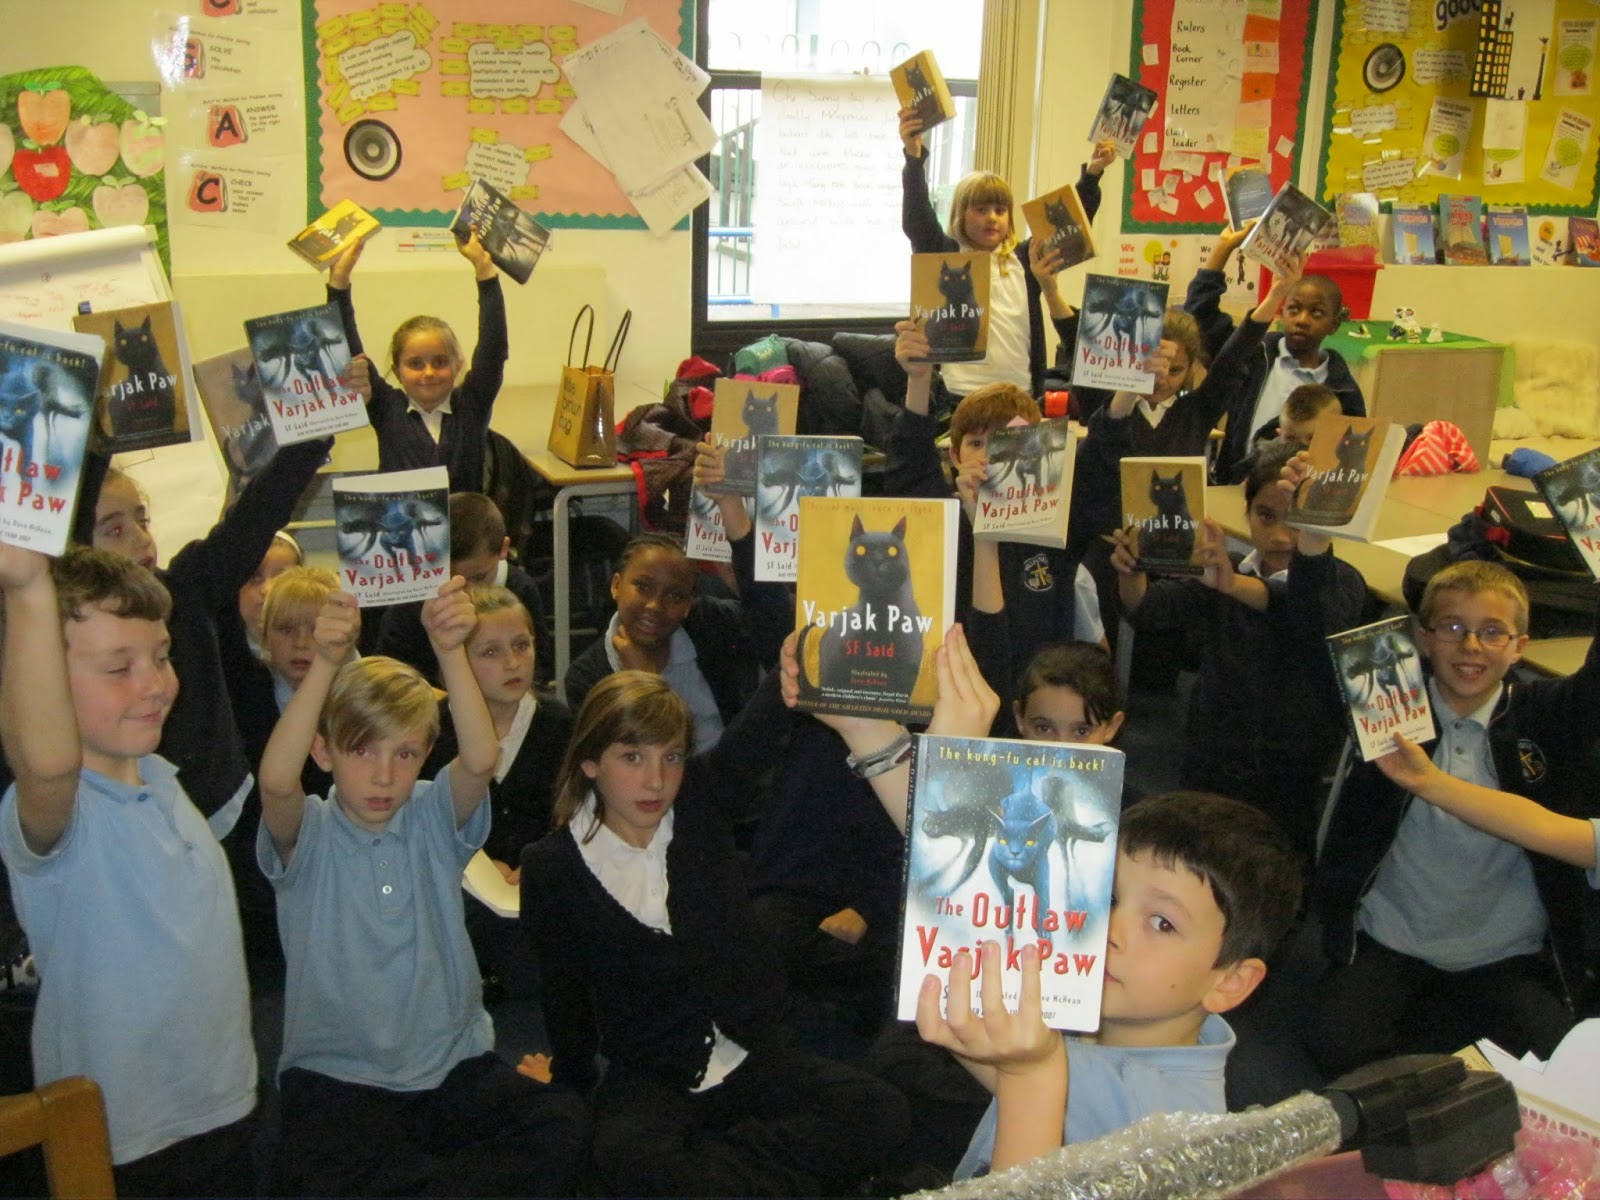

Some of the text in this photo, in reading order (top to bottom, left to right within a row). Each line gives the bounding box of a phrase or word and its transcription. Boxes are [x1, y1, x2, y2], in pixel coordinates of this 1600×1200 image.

[1177, 20, 1205, 33] Rulers
[209, 45, 233, 55] SOLVE
[358, 48, 372, 57] solve
[374, 42, 390, 51] simple
[392, 35, 411, 46] number
[1172, 44, 1191, 54] Book
[344, 59, 369, 72] problems
[1176, 55, 1203, 64] Corner
[1169, 75, 1206, 91] Register
[246, 105, 276, 114] ANSWER
[215, 111, 239, 140] A
[497, 158, 517, 167] number
[197, 178, 220, 205] C
[231, 179, 253, 187] CHECK
[1121, 244, 1135, 253] We
[1118, 267, 1139, 276] kind
[915, 304, 985, 322] Varjak Paw
[1104, 336, 1150, 353] Outlaw
[57, 356, 87, 369] back!
[1082, 347, 1144, 371] Varjak Pa
[102, 372, 178, 401] arjak Paw
[293, 374, 350, 395] Outlaw
[272, 391, 359, 418] Varjak Paw
[222, 414, 271, 440] Varjak
[293, 420, 309, 431] Said
[3, 447, 63, 482] tlaw
[1305, 465, 1369, 485] Varjak Paw
[17, 478, 67, 515] Paw
[1006, 482, 1057, 501] Outlaw
[981, 498, 1059, 521] Varjak Paw
[770, 517, 786, 528] The
[992, 522, 1007, 530] Said
[1127, 514, 1200, 533] Varjak Paw
[762, 531, 798, 559] Varj
[374, 552, 438, 569] Outlaw
[767, 560, 792, 570] SF Said
[345, 566, 445, 590] Varjak Paw
[803, 600, 933, 638] Varjak Paw
[846, 640, 897, 658] SF Said
[851, 669, 880, 677] Illustrated
[1376, 688, 1419, 712] Outlaw
[891, 707, 909, 716] GOLD
[1359, 704, 1427, 735] Varjak Paw
[939, 746, 1105, 772] The kung-fu cat is back!
[907, 769, 916, 810] Outlaw
[936, 892, 1088, 934] The Outlaw
[916, 925, 1097, 981] Vajk Paw
[1053, 995, 1082, 1005] McKean
